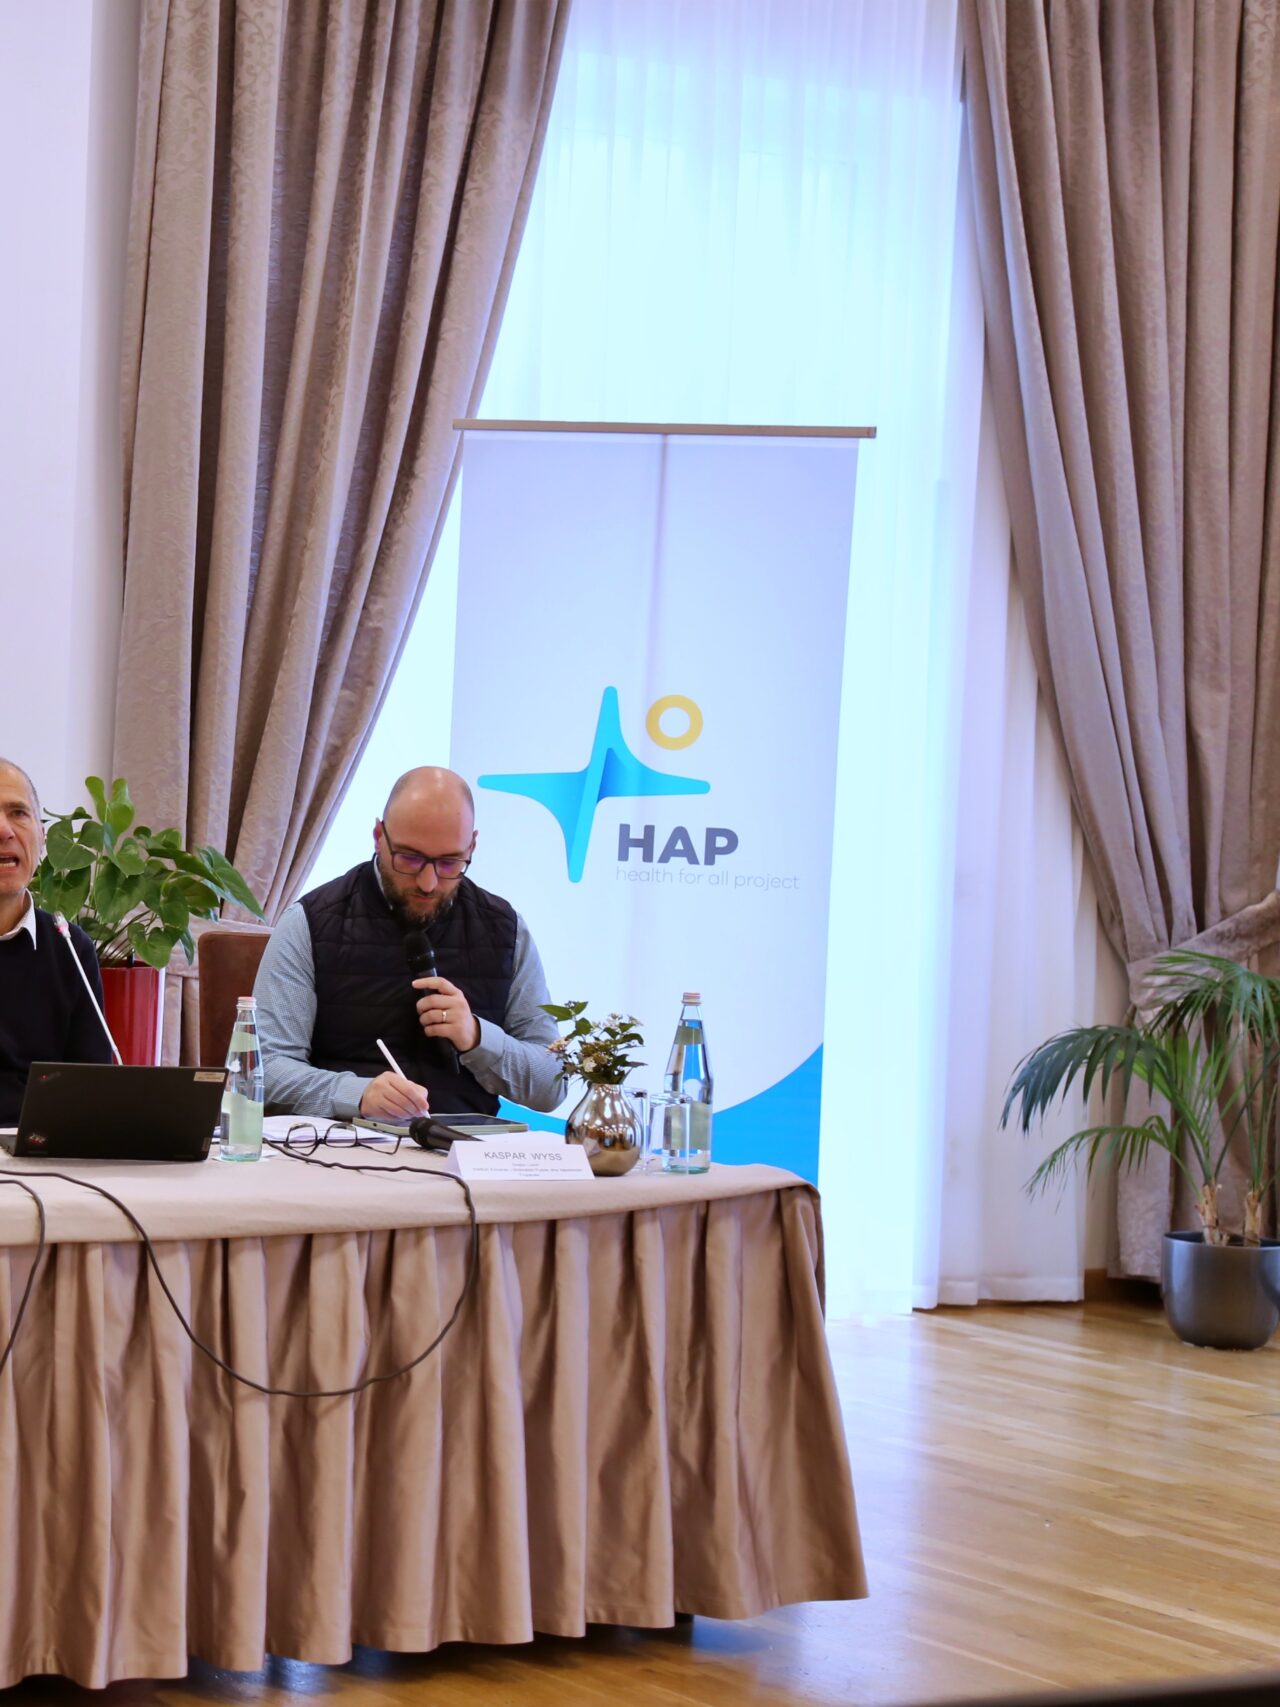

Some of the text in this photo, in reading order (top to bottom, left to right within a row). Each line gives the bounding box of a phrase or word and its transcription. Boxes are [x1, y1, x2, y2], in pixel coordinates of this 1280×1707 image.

[618, 823, 739, 866] HAP
[616, 866, 800, 892] health for all project
[483, 1151, 563, 1161] KASPAR WYSS
